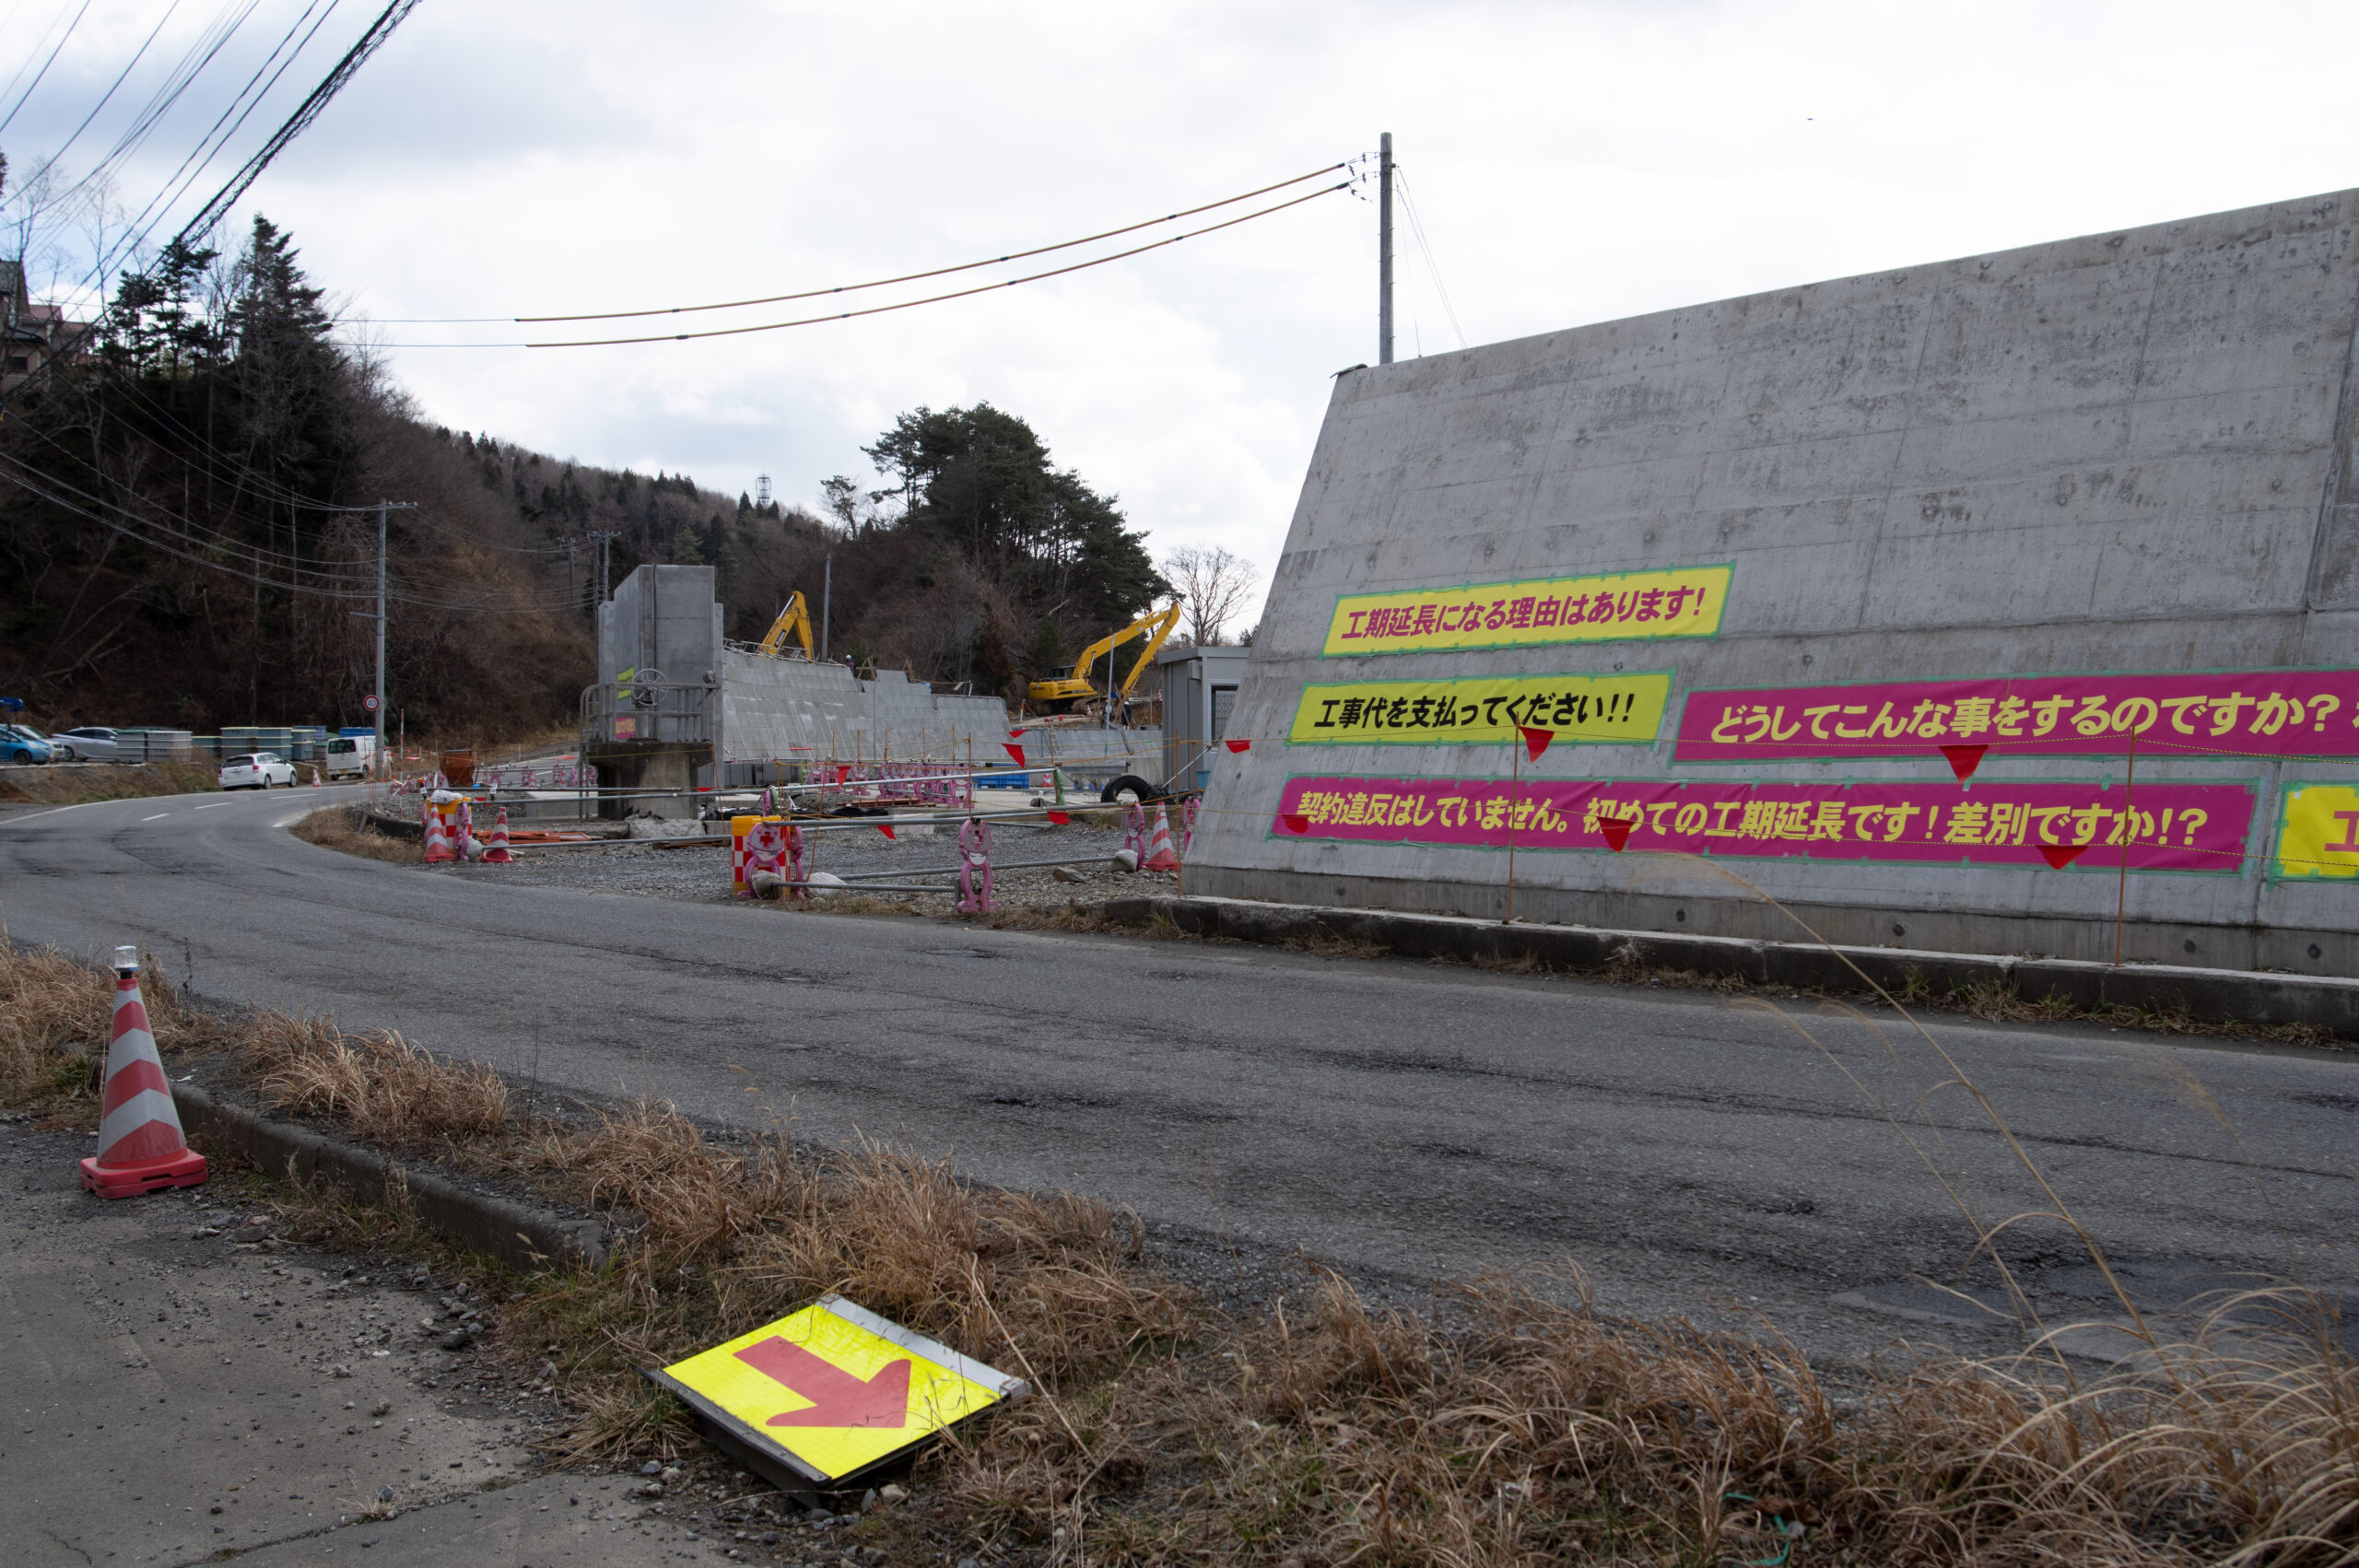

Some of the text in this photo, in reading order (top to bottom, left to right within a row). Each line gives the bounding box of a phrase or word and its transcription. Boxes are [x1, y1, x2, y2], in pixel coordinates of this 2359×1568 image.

[1342, 585, 1706, 639] 工期延長になる理由はあります!
[1314, 693, 1635, 729] 工事代を支払ってください!!
[1711, 693, 2359, 743] どうしてこんな事をするのですか?
